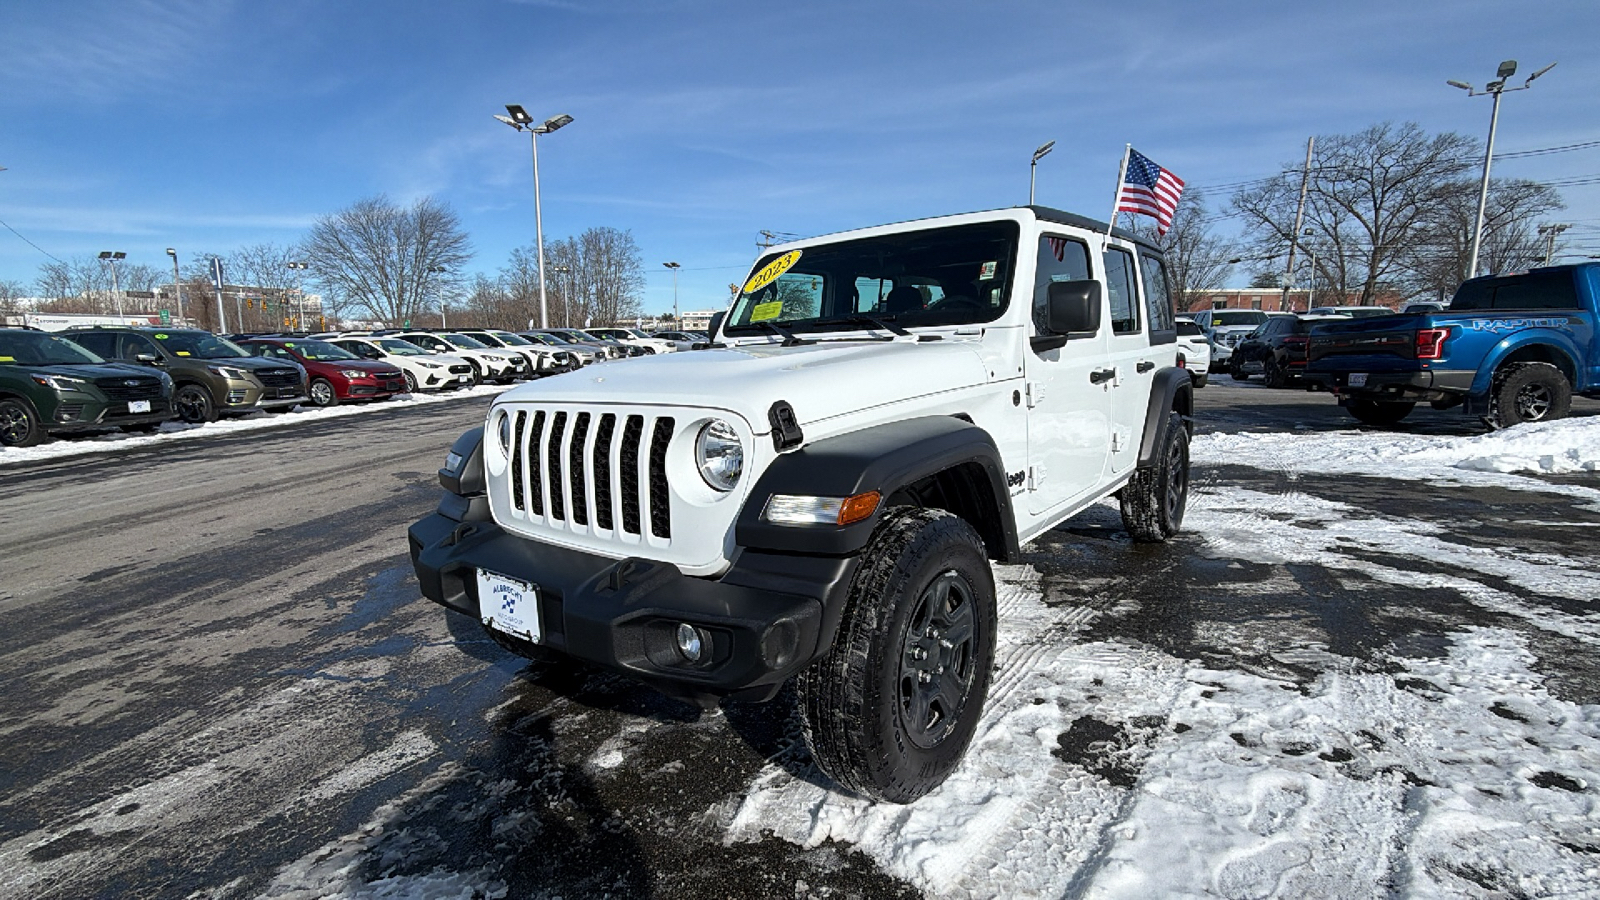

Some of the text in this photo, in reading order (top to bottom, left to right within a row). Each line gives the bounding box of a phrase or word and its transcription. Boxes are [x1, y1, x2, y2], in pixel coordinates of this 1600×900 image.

[754, 254, 792, 288] 2023
[1472, 317, 1572, 334] RAPTOR
[493, 585, 522, 602] ALBRECHT
